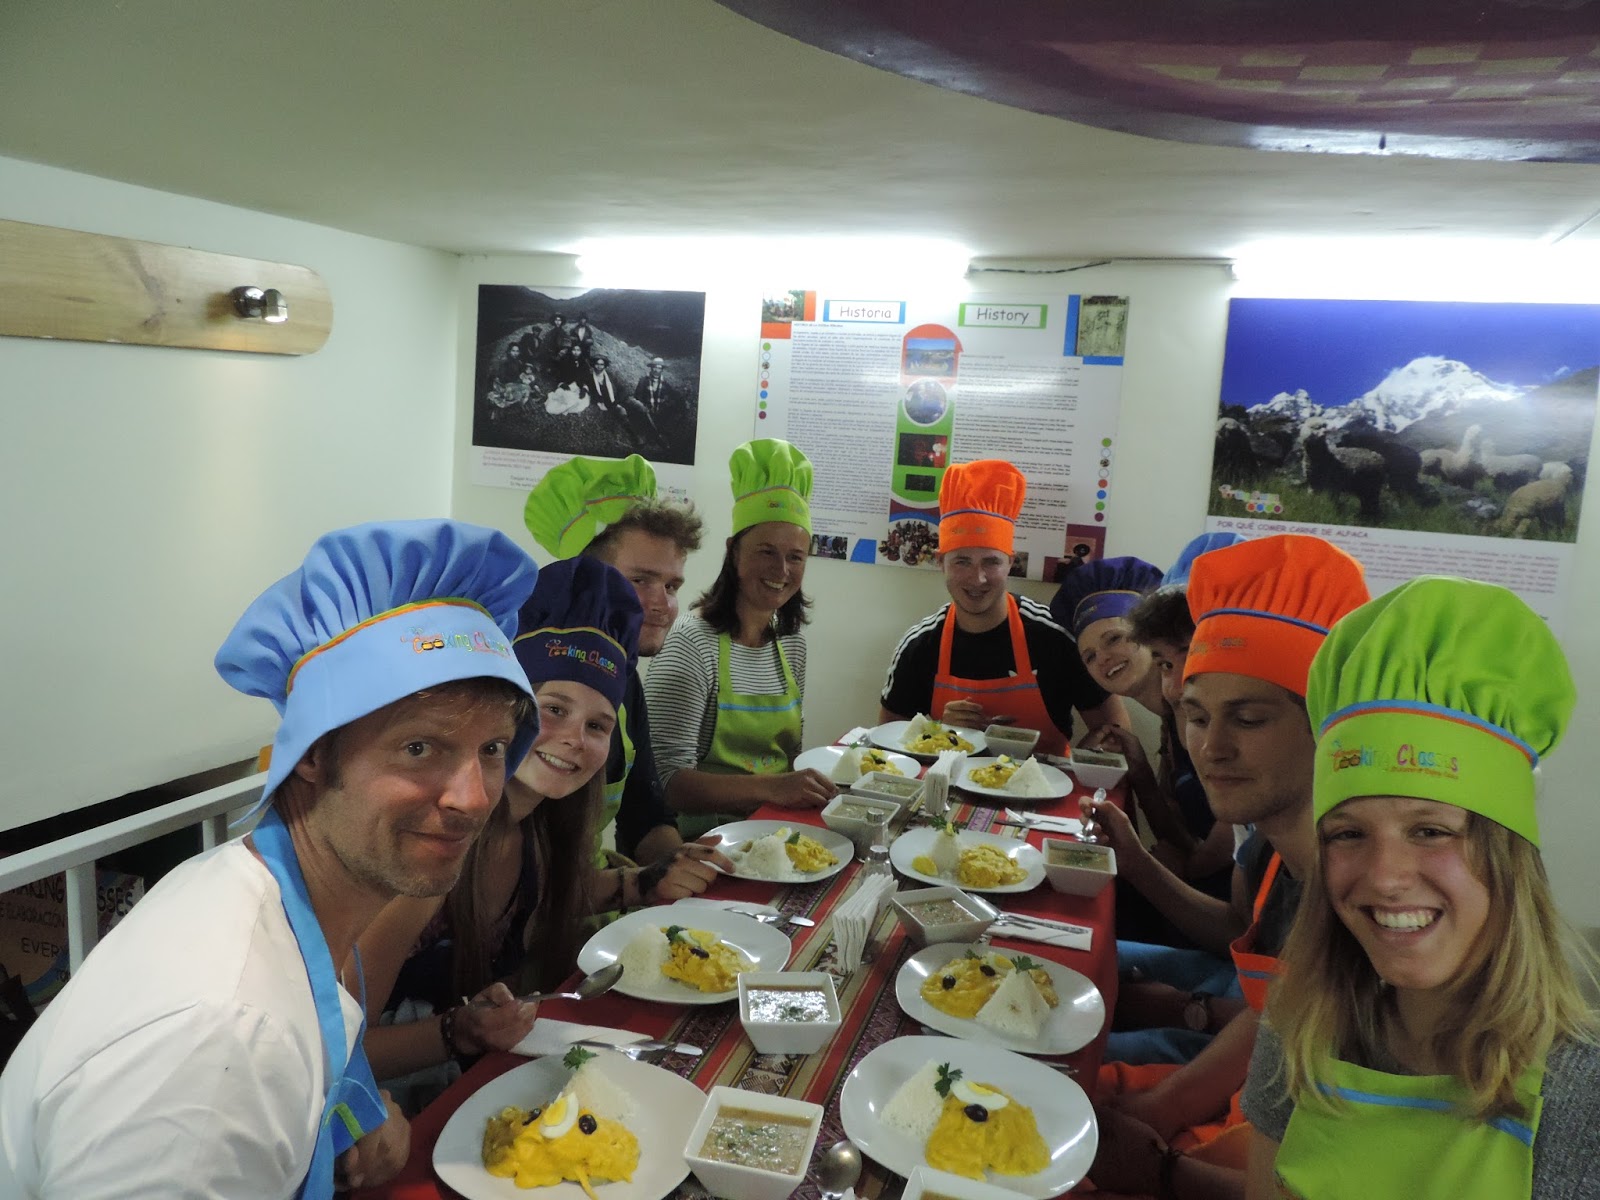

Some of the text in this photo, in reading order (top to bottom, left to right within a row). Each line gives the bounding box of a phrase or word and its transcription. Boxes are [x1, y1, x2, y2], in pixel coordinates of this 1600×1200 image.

[840, 306, 892, 319] Historia
[976, 307, 1029, 325] History
[548, 644, 587, 663] Cooking
[588, 649, 618, 674] Classes
[1397, 744, 1459, 773] Class
[12, 876, 65, 904] AKING
